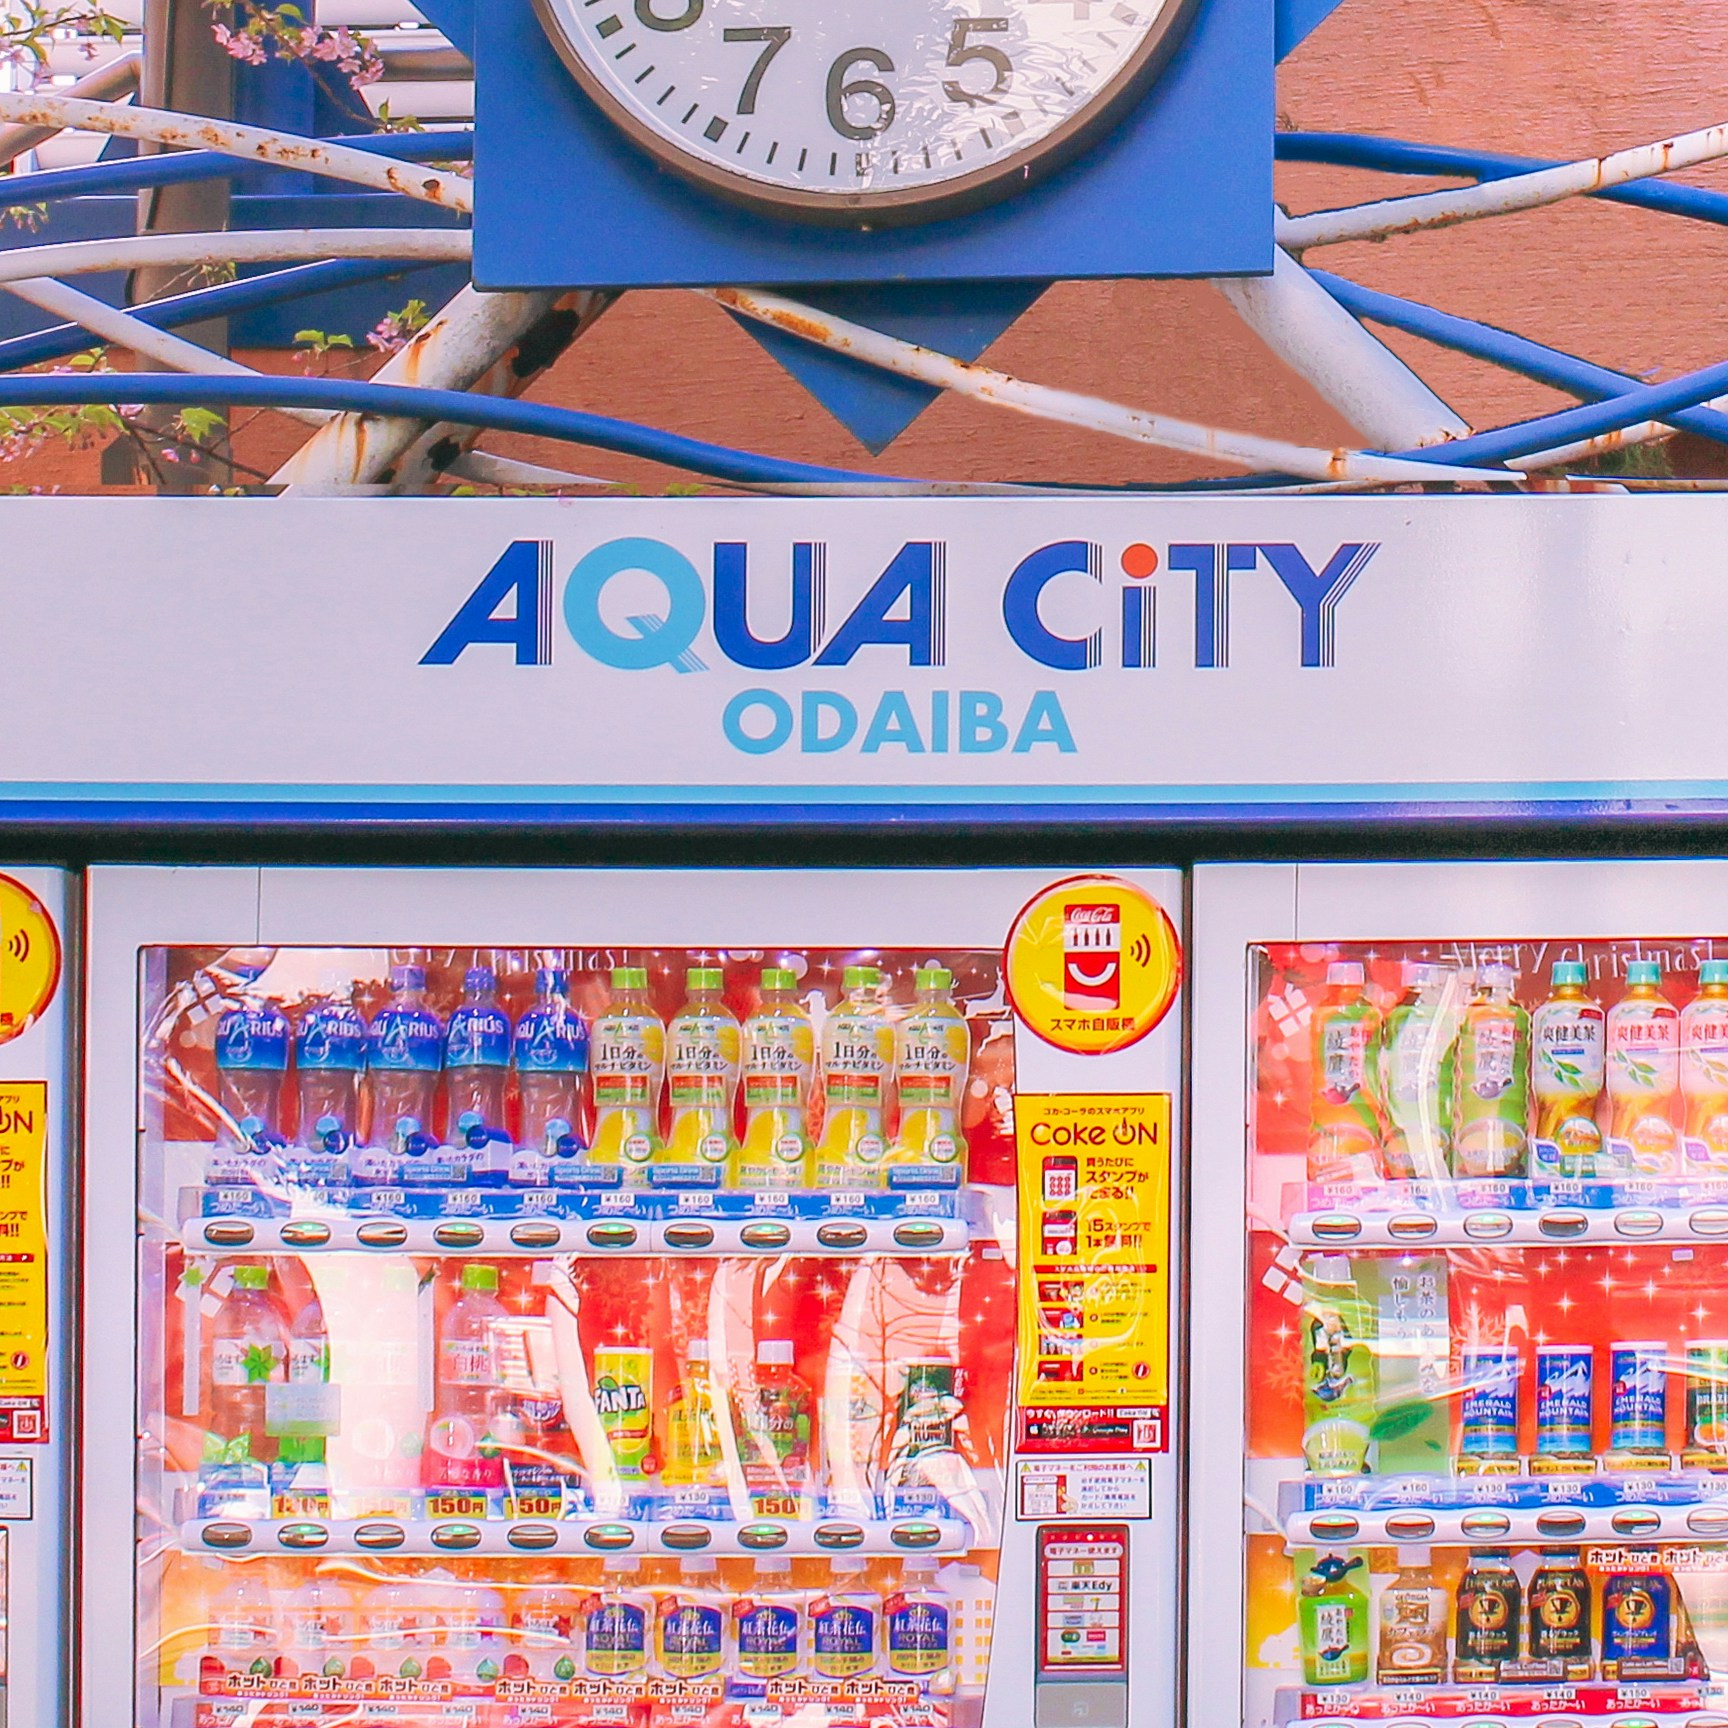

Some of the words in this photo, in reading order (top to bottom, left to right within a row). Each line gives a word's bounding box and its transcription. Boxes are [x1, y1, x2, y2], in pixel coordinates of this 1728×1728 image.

[945, 17, 1012, 107] 5
[724, 26, 790, 114] 7
[826, 47, 895, 141] 6
[416, 534, 948, 675] AQUA
[721, 687, 1079, 754] ODAIBA
[1050, 1017, 1135, 1031] スマホ自販機
[1543, 1024, 1596, 1043] 爽健美茶
[1617, 1024, 1669, 1042] 爽健美茶
[1031, 1122, 1106, 1146] Coke
[1113, 1117, 1157, 1145] ON
[1086, 1157, 1134, 1167] 買うたびに
[1086, 1171, 1149, 1183] スタンプが
[603, 1194, 632, 1204] ¥160
[681, 1194, 711, 1205] ¥160
[757, 1193, 787, 1204] ¥160
[833, 1194, 862, 1205] ¥160
[453, 1355, 488, 1372] 白桃
[594, 1383, 646, 1414] FANTA
[1616, 1396, 1661, 1406] EMERALD
[1465, 1399, 1511, 1410] EMERALD
[1541, 1400, 1587, 1410] EMERALD
[1614, 1405, 1662, 1414] MOUNTAIN
[1464, 1409, 1513, 1418] MOUNTAIN
[1540, 1409, 1588, 1418] MOUNTAIN
[1476, 1484, 1504, 1494] ¥130
[1552, 1484, 1579, 1494] ¥130
[1627, 1481, 1654, 1492] ¥130
[1701, 1480, 1727, 1491] ¥130
[429, 1499, 483, 1515] 150円
[1072, 1580, 1112, 1591] 楽天Edy
[1395, 1692, 1423, 1701] ¥140
[1470, 1691, 1498, 1701] ¥140
[1546, 1689, 1574, 1700] ¥140
